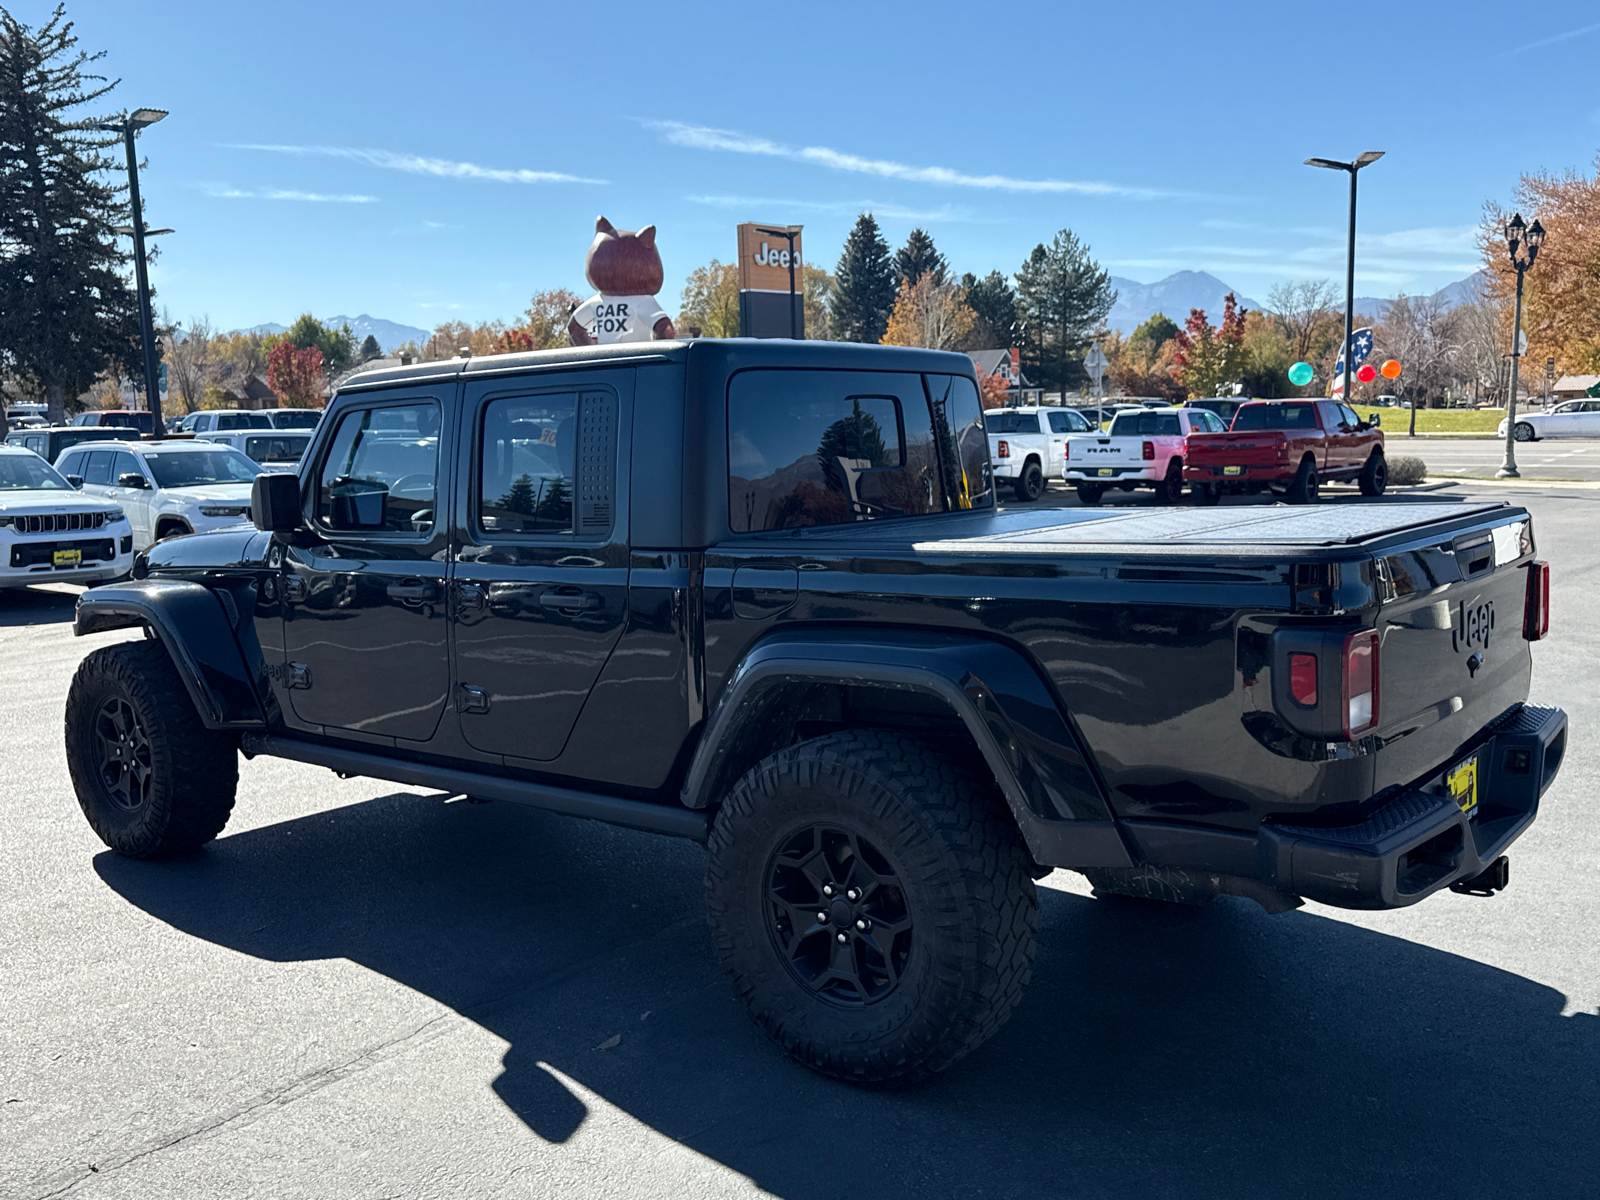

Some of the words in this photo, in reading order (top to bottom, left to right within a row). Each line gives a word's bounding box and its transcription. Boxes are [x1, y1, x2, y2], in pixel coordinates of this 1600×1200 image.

[754, 242, 801, 269] Jeep
[596, 303, 629, 318] CAR
[597, 318, 629, 334] FOX
[1452, 599, 1495, 653] Jeep
[256, 659, 282, 682] Jeep
